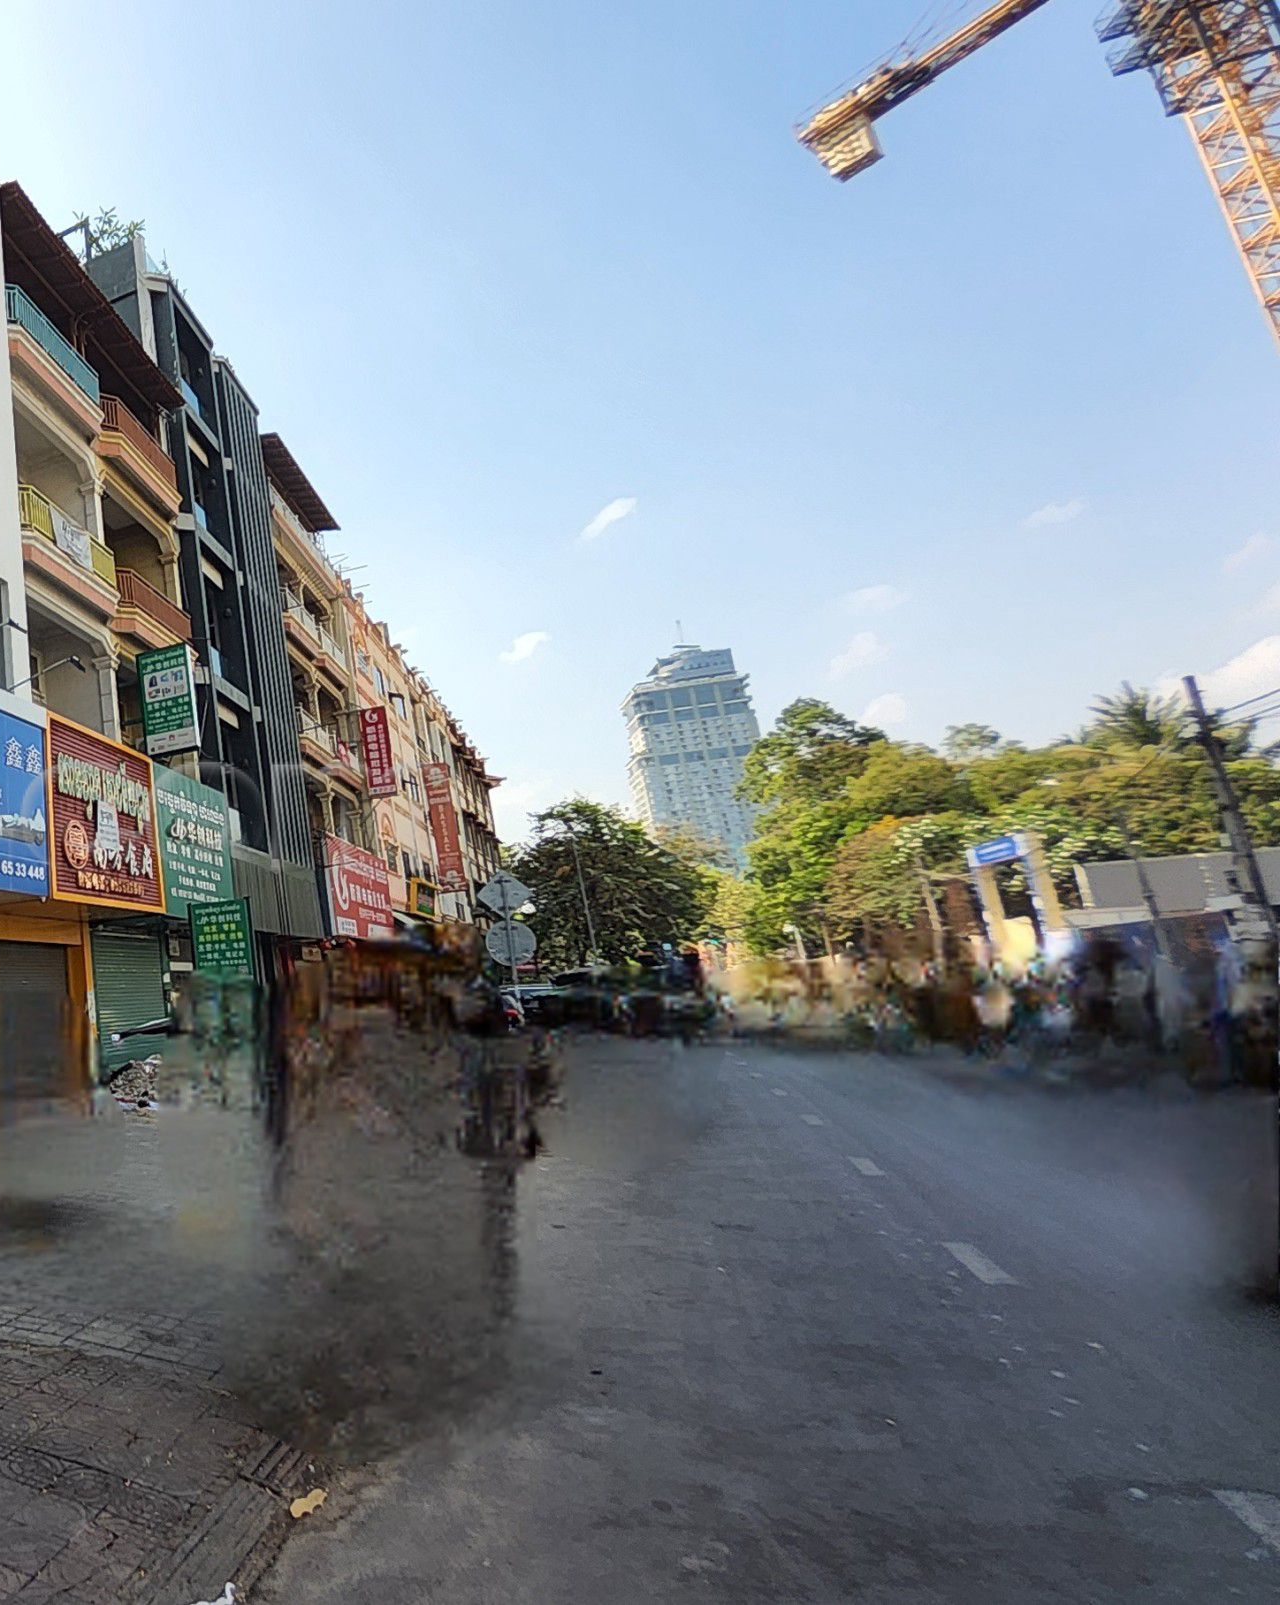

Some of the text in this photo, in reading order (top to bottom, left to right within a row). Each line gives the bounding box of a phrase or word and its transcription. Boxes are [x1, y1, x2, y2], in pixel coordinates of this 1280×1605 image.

[4, 736, 42, 776] 鑫鑫
[1, 859, 14, 876] 65
[14, 862, 27, 878] 33
[27, 864, 46, 881] 448
